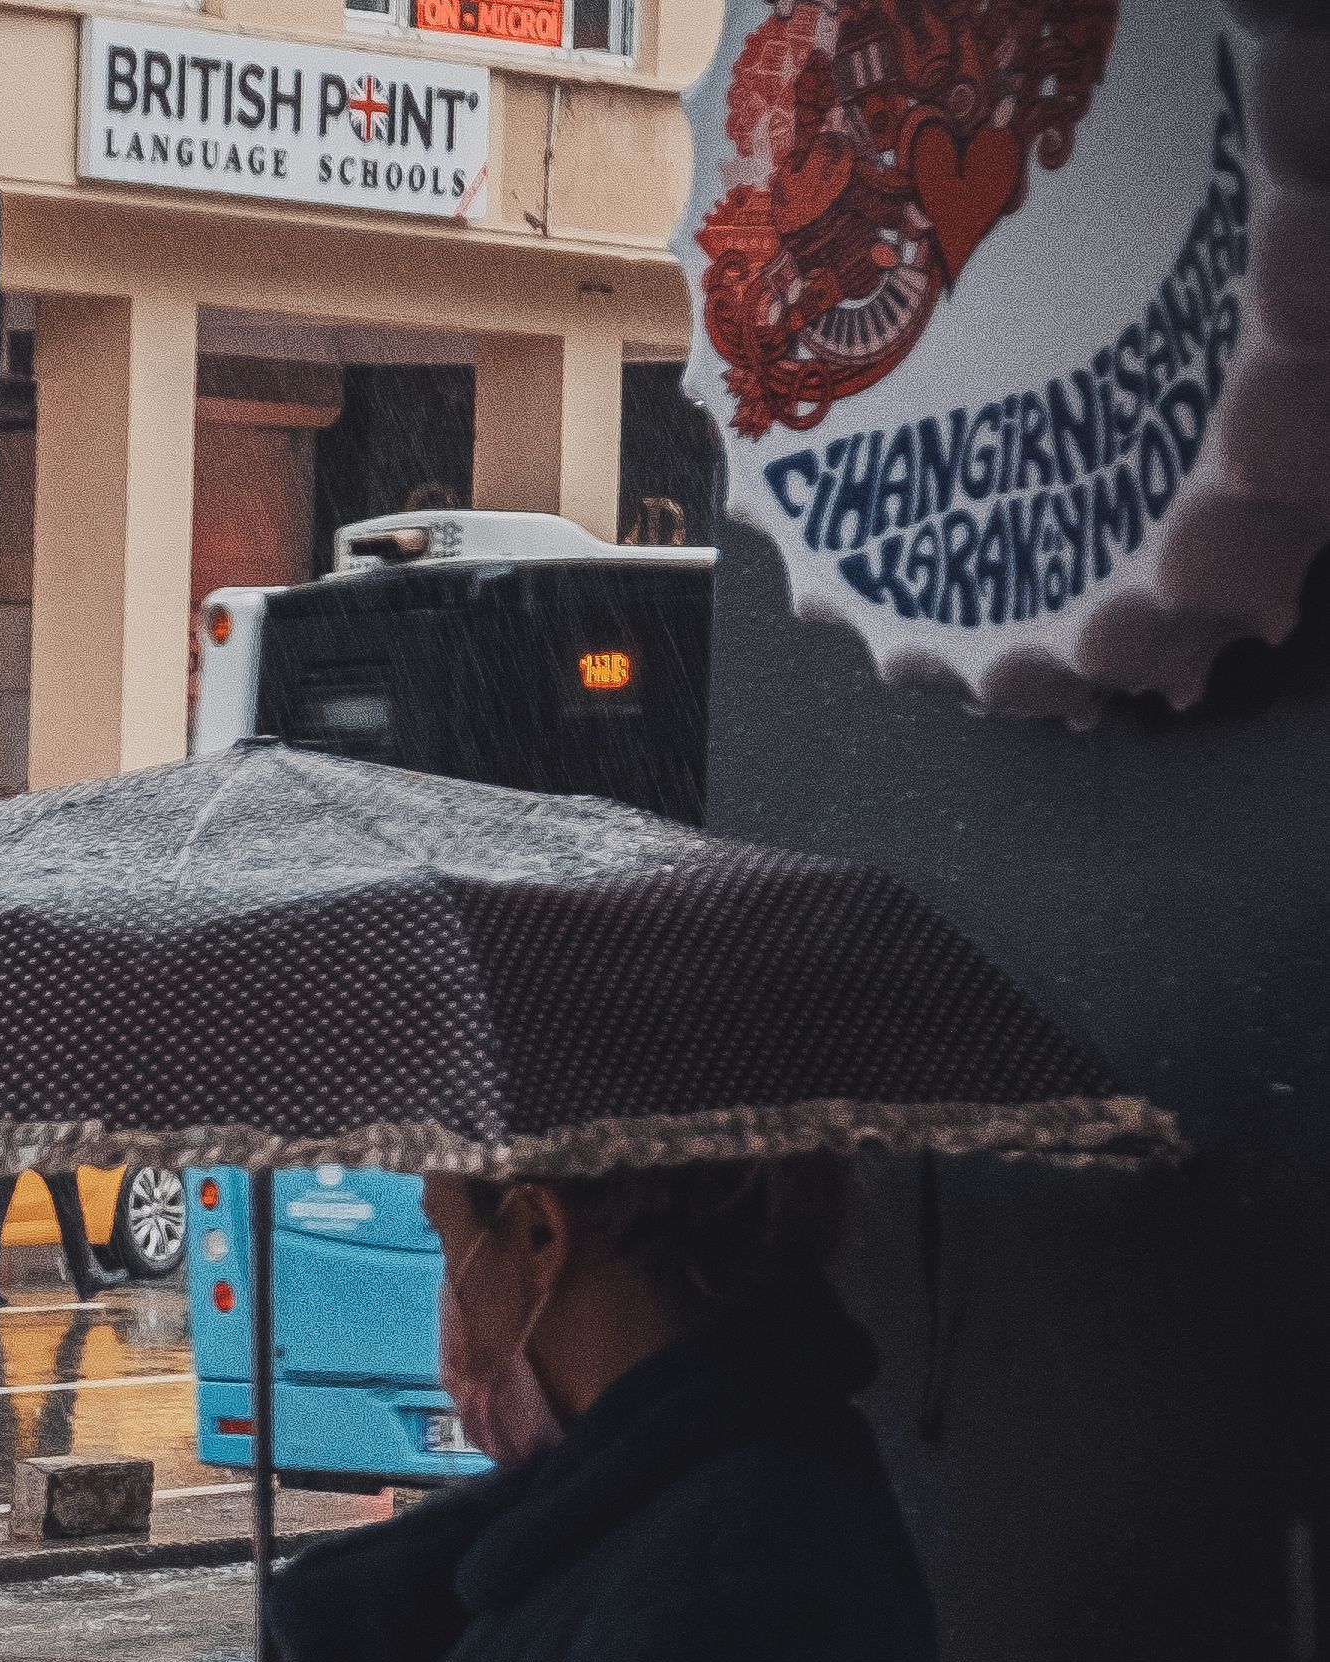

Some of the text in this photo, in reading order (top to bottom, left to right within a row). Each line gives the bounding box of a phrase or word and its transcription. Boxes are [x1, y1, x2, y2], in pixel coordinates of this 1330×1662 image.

[107, 45, 303, 134] BRITISH
[104, 127, 466, 198] LANGUAGE SCHOOLS
